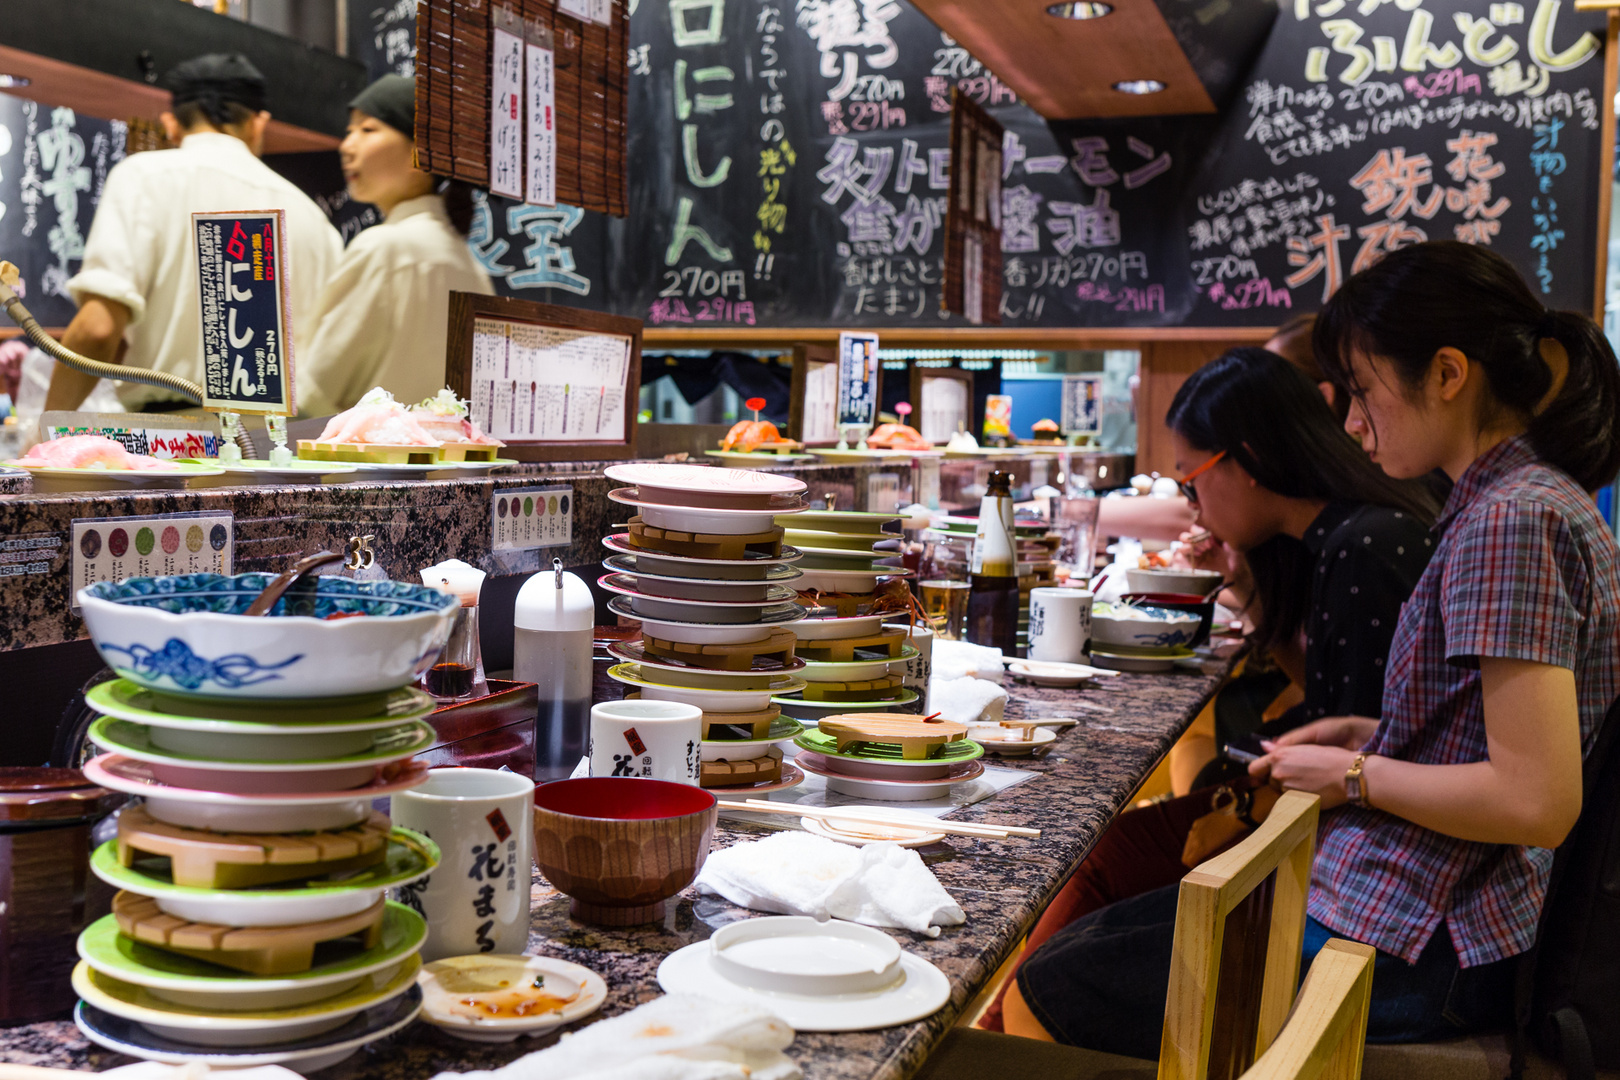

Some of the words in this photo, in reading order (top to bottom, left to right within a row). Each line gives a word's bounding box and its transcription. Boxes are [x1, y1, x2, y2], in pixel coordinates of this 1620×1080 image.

[930, 47, 992, 79] 270
[849, 75, 905, 101] 270円
[1338, 81, 1404, 110] 270円
[658, 266, 747, 299] 270円
[1190, 254, 1260, 285] 270円
[266, 329, 279, 376] 270円
[344, 534, 375, 570] 35
[468, 843, 506, 953] 花まる
